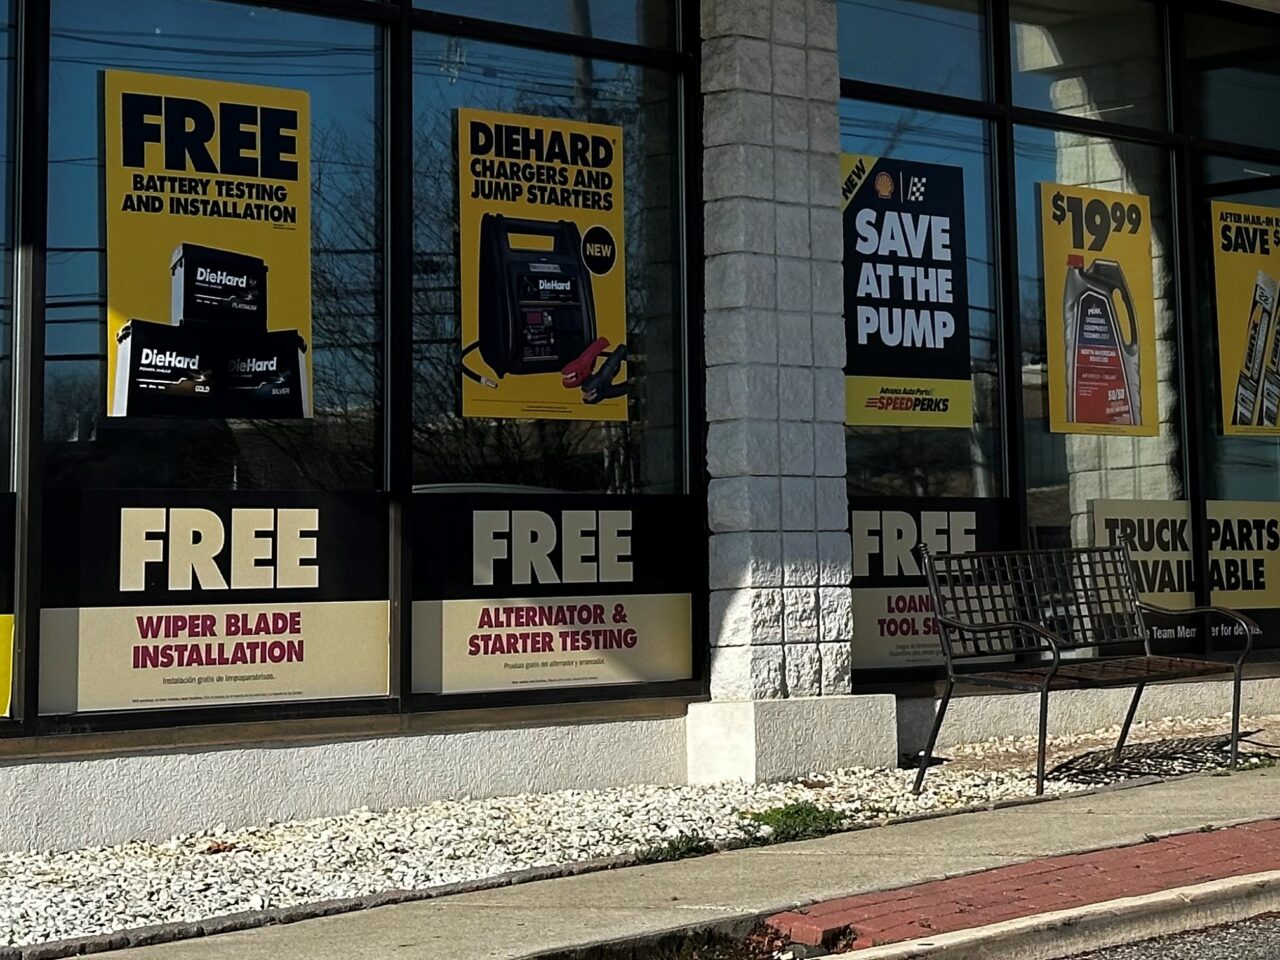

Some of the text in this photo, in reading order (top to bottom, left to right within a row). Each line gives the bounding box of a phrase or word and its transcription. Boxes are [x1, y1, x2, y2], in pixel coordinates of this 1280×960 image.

[121, 92, 299, 182] FREE
[469, 120, 614, 169] DIEHARD
[132, 174, 288, 202] BATTERY TESTING
[470, 157, 613, 191] CHARGERS AND
[842, 157, 866, 200] NEW
[121, 194, 297, 224] AND INSTALLATION
[471, 179, 613, 212] JUMP STARTERS
[1219, 211, 1242, 223] AFTER
[1243, 214, 1273, 227] MAIL-IN
[855, 207, 952, 261] SAVE
[1221, 224, 1270, 255] SAVE
[585, 243, 612, 258] NEW
[196, 267, 248, 288] DieHard
[538, 279, 571, 291] DieHard
[856, 262, 954, 304] AT THE
[857, 305, 955, 349] PUMP
[140, 348, 200, 370] DieHard
[227, 356, 278, 372] DieHard
[877, 395, 950, 412] SPEEDPERKS
[119, 507, 319, 591] FREE
[473, 510, 634, 585] FREE
[852, 510, 978, 577] FREE
[1105, 519, 1280, 552] TRUCK PARTS
[136, 611, 302, 639] WIPER BLADE
[477, 603, 628, 629] ALTERNATOR &
[877, 618, 919, 637] TOOL
[468, 628, 638, 656] STARTER TESTING
[1151, 626, 1176, 639] Team
[1177, 625, 1220, 638] Memer
[1220, 623, 1232, 636] for
[132, 640, 304, 669] INSTALLATION
